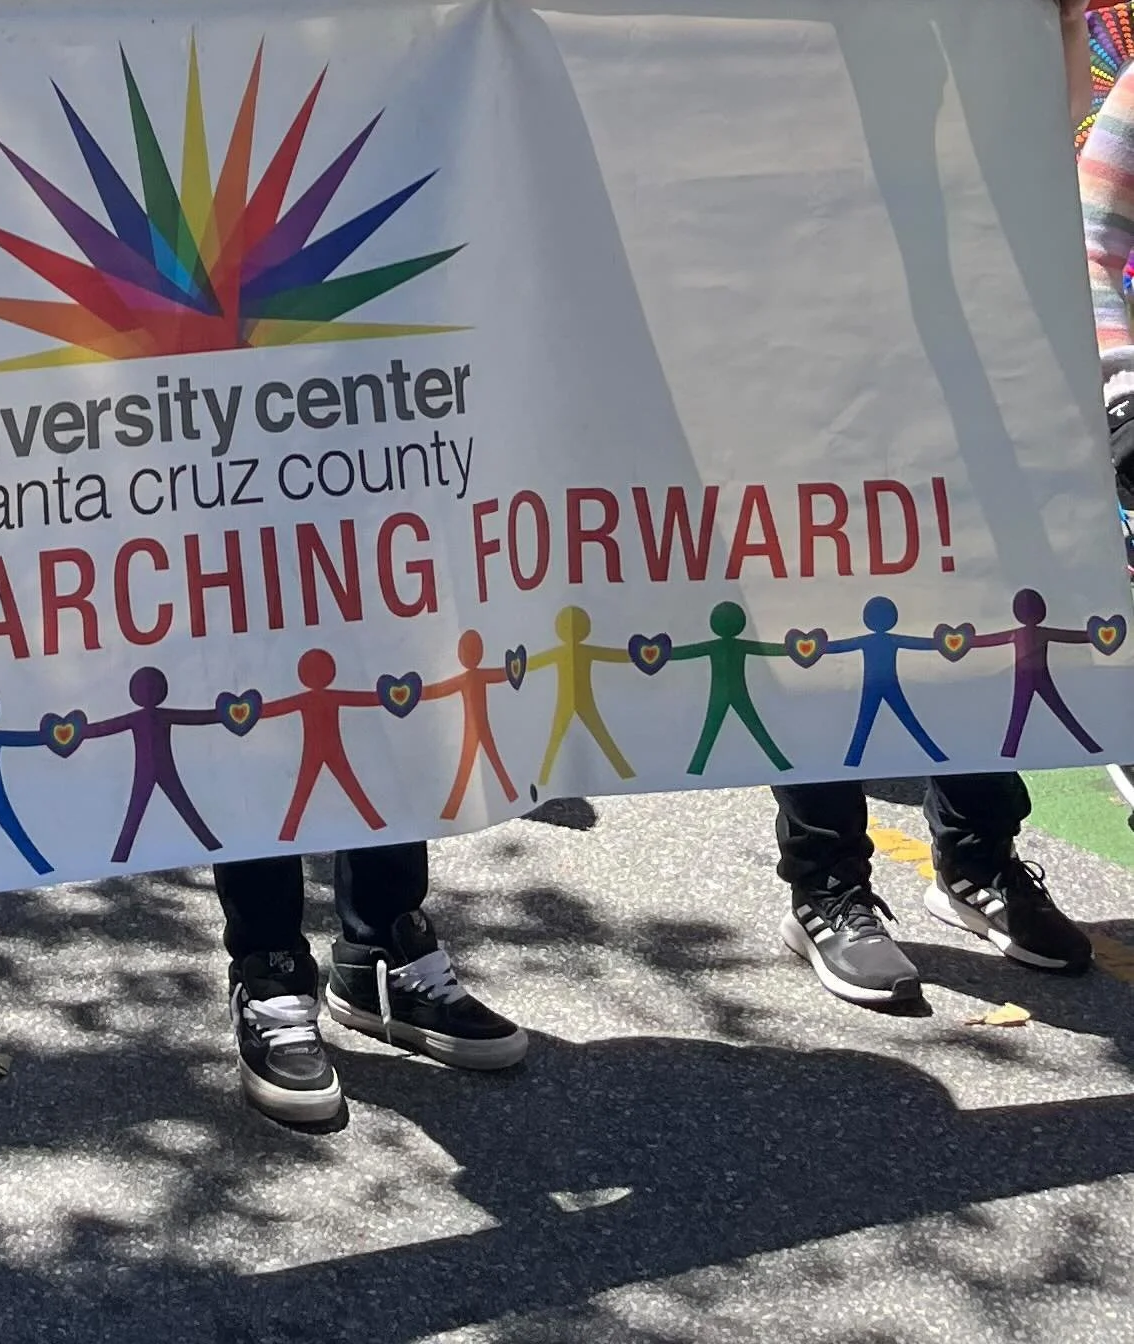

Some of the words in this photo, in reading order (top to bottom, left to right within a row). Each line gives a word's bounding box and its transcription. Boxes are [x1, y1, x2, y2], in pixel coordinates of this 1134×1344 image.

[255, 359, 471, 434] center
[129, 457, 264, 515] cruz
[278, 430, 474, 499] county
[472, 476, 957, 603] FORWARD!
